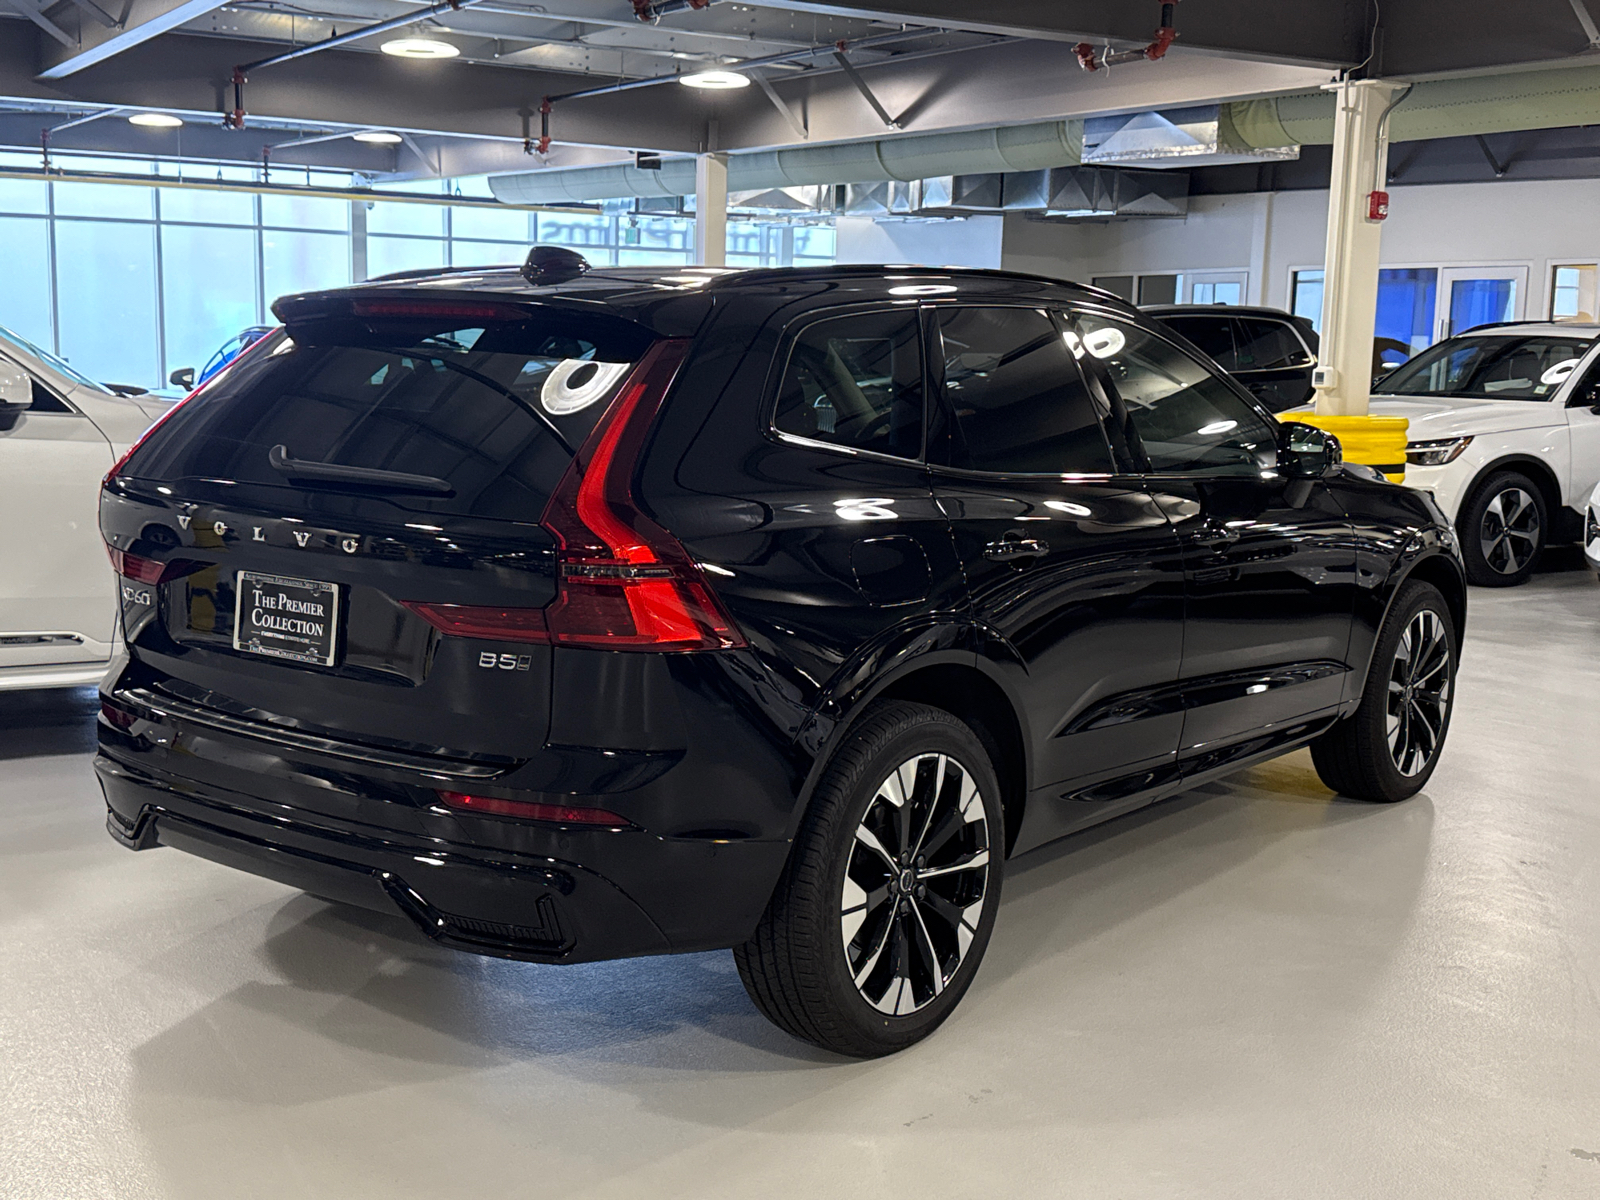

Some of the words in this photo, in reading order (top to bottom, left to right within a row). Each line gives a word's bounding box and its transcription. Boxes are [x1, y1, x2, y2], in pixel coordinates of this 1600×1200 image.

[176, 515, 359, 554] VOLVO
[252, 589, 277, 609] THE
[278, 593, 325, 617] PREMIER
[251, 608, 325, 637] COLLECTION
[478, 651, 518, 670] B5
